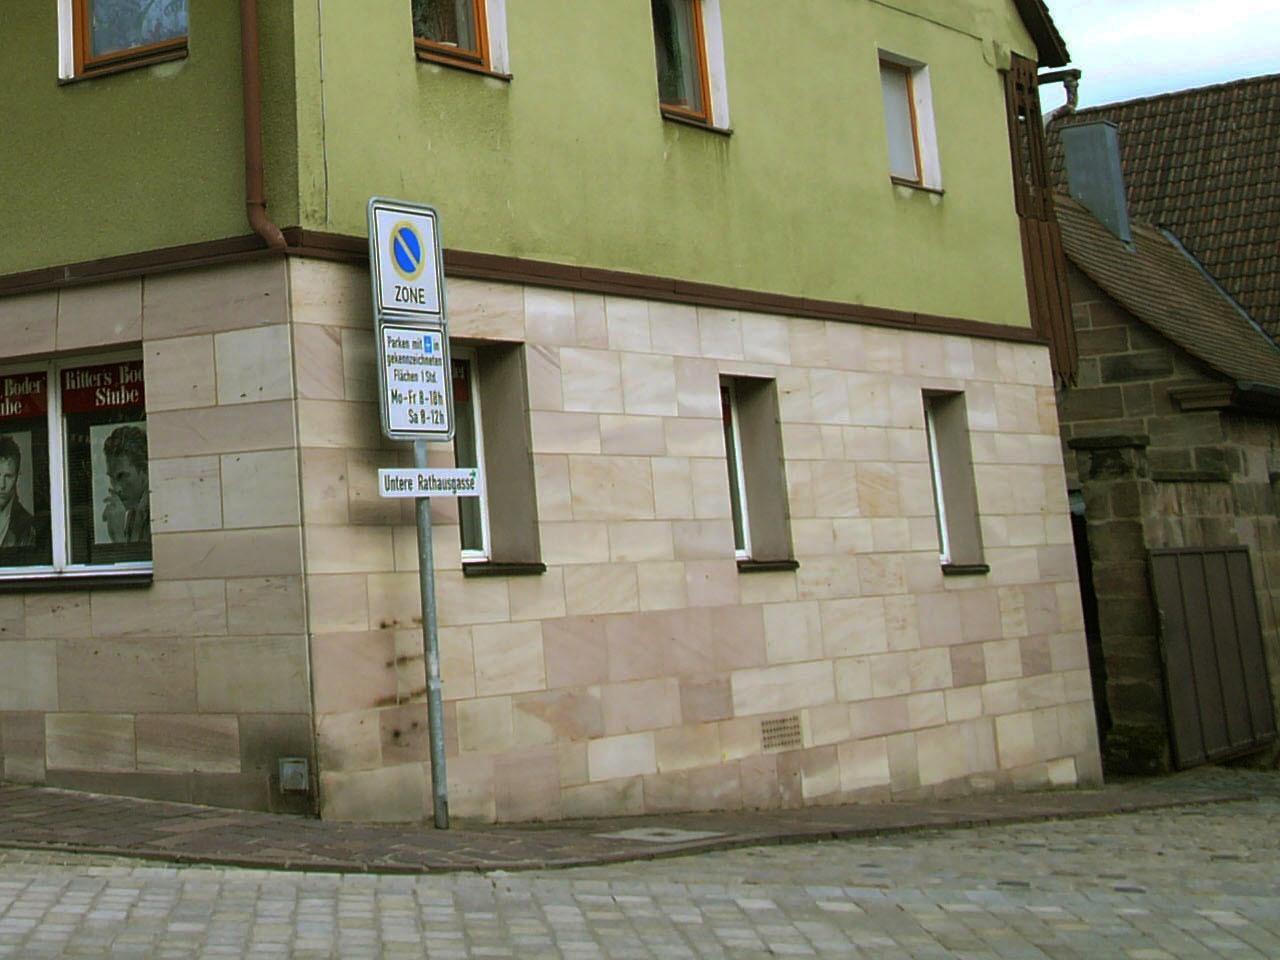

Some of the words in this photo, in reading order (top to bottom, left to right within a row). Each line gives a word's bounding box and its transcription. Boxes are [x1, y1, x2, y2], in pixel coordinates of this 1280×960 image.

[395, 285, 426, 305] ZONE
[387, 335, 410, 349] Parken
[393, 368, 418, 382] Flächen
[95, 385, 139, 407] Stube
[408, 408, 418, 424] Sa
[384, 474, 413, 492] Untere
[417, 473, 475, 494] Rathausgasse
